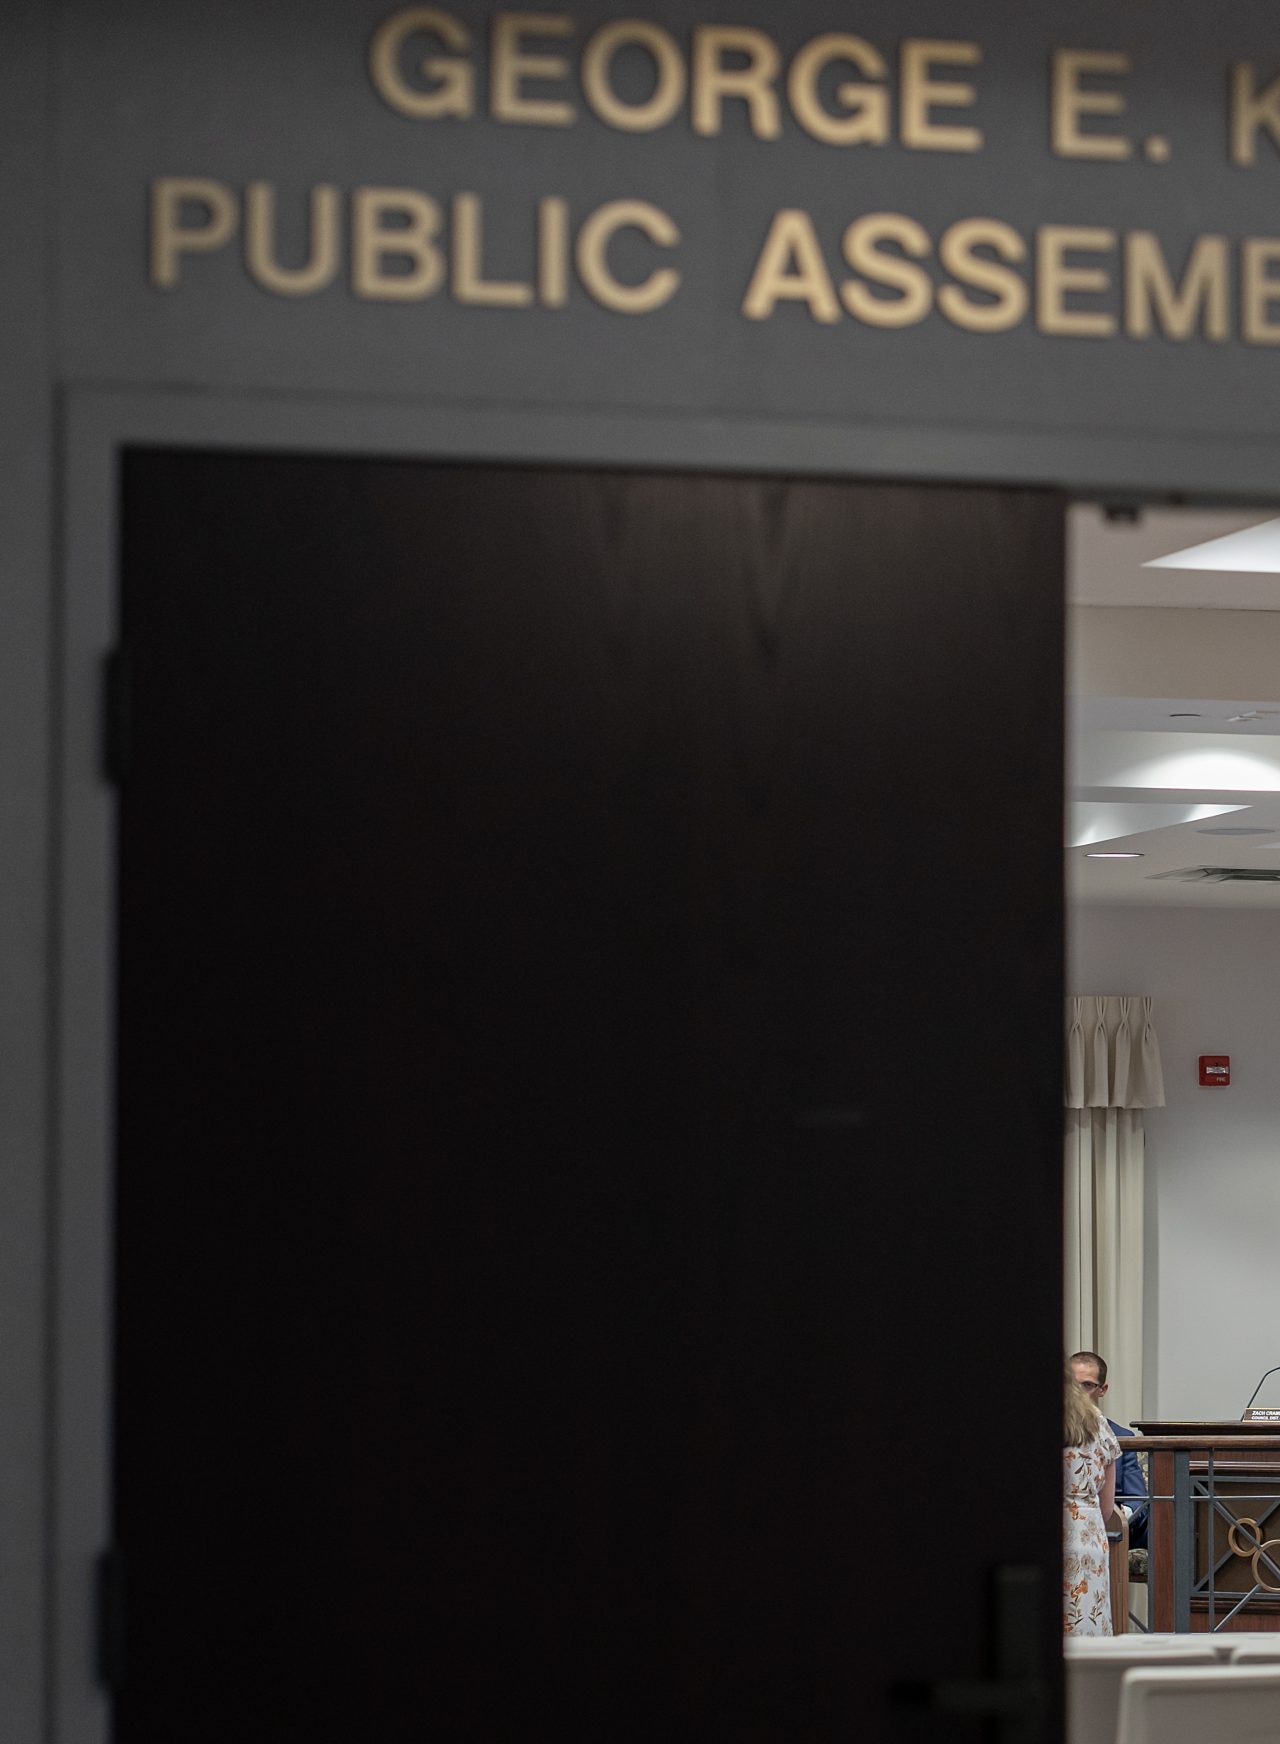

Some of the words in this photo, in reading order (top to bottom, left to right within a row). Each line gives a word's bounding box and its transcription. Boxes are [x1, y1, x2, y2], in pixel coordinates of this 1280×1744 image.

[371, 8, 983, 152] GEORGE
[1051, 47, 1170, 162] E.
[149, 178, 682, 314] PUBLIC
